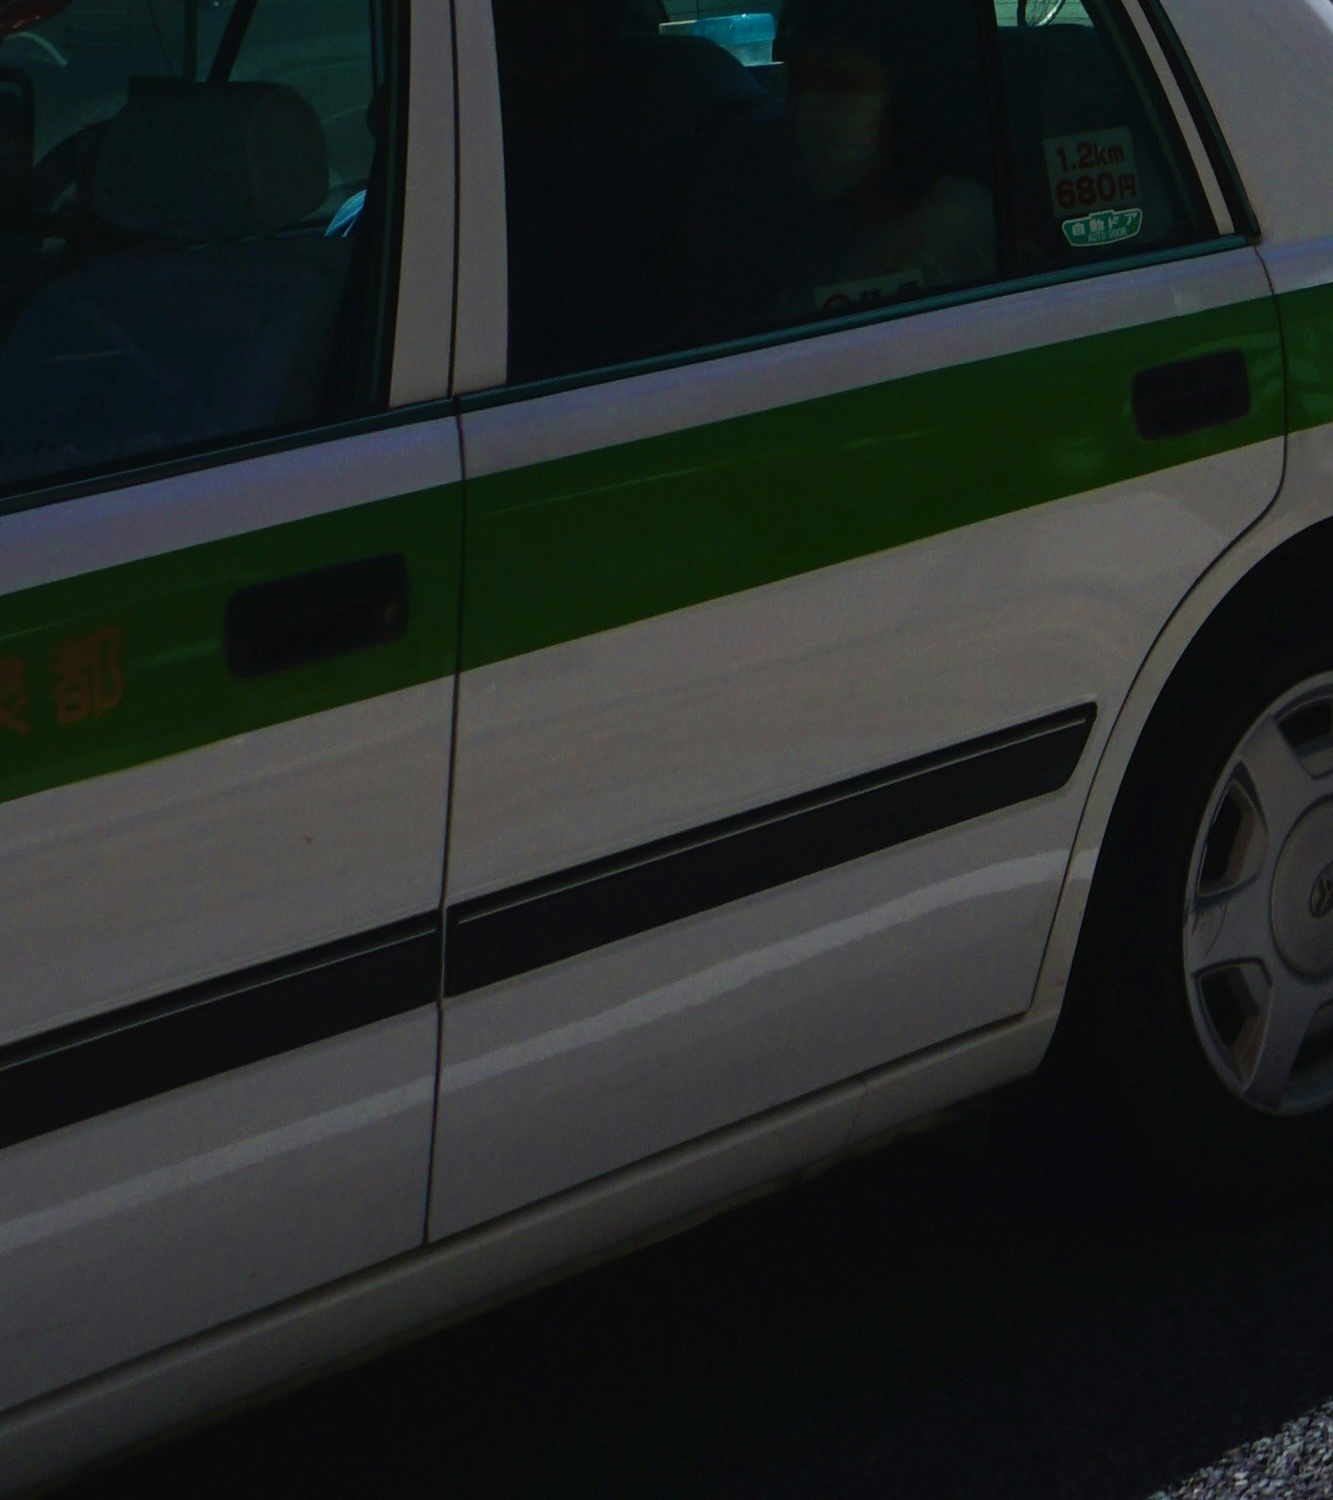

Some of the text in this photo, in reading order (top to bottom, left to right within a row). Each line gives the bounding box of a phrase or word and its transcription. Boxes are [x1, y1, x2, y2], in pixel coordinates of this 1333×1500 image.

[1056, 140, 1124, 173] 1.2km
[1056, 171, 1137, 209] 680円
[1071, 212, 1138, 237] 自動ドア
[1088, 230, 1107, 243] AUTO
